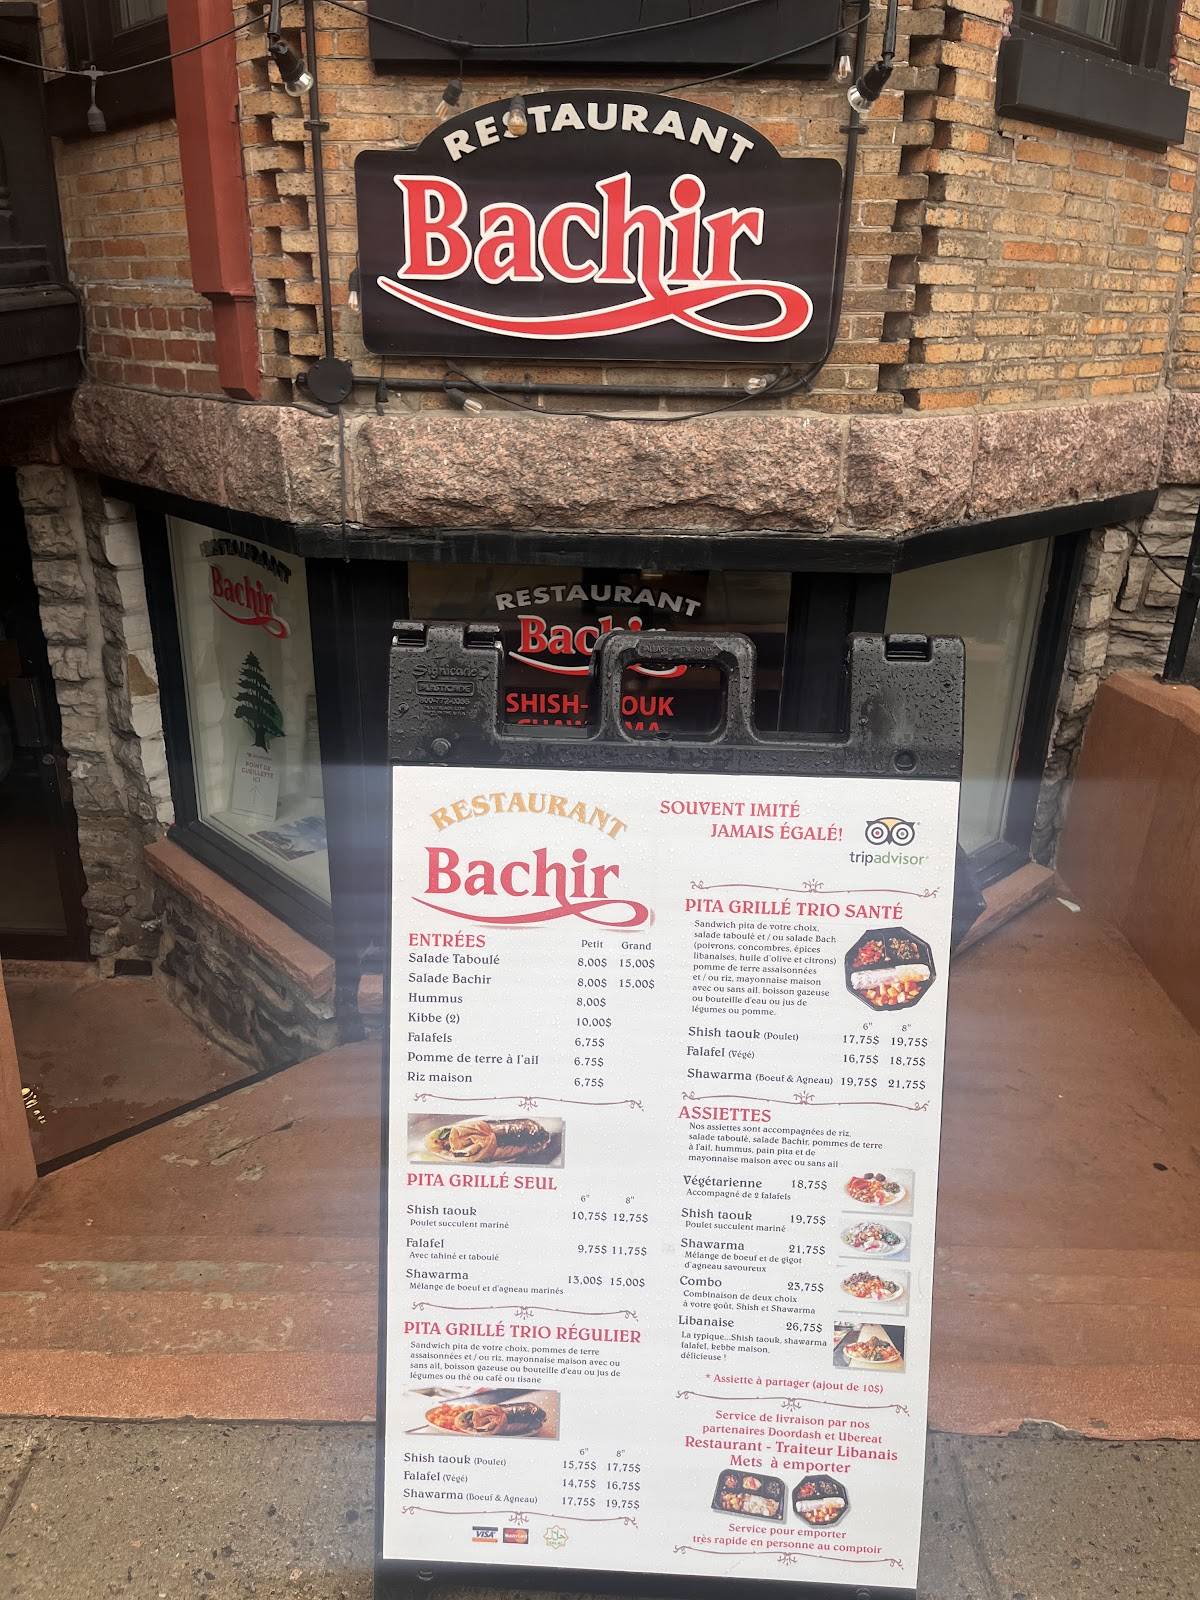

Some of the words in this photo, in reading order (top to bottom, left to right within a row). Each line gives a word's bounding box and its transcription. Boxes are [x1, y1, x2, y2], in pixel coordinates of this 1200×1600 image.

[442, 102, 754, 164] RESTAURANT
[377, 172, 814, 342] Bachir
[496, 584, 701, 616] RESTAURANT
[660, 801, 745, 816] SOUVENT
[750, 800, 800, 817] IMITÉ
[430, 792, 628, 840] RESTAURANT
[711, 824, 774, 839] JAMAIS
[780, 822, 842, 841] ÉGALÉ!
[849, 851, 924, 865] tripadvisor
[411, 847, 649, 927] Bachir
[685, 899, 723, 912] PITA
[729, 898, 790, 915] GRILLÉ
[797, 903, 840, 917] TRIO
[845, 902, 902, 919] SANTÉ
[694, 920, 735, 928] Sandwich
[739, 922, 754, 930] pita
[409, 930, 485, 948] ENTRÉES
[582, 940, 602, 948] Petit
[622, 942, 651, 950] Grand
[409, 953, 449, 963] Salade
[453, 954, 499, 964] Taboulé
[409, 973, 448, 983] Salade
[453, 974, 491, 984] Bachir
[409, 993, 462, 1003] Hummus
[409, 1013, 442, 1022] Kibbe
[446, 1013, 459, 1024] (2)
[408, 1032, 452, 1042] Falafels
[689, 1027, 721, 1037] Shish
[726, 1029, 760, 1038] taouk
[764, 1032, 798, 1041] (Poulet)
[408, 1052, 453, 1062] Pomme
[457, 1053, 471, 1062] de
[475, 1055, 502, 1063] terre
[506, 1054, 512, 1063] à
[517, 1055, 538, 1064] l'ail
[687, 1046, 725, 1057] Falafel
[729, 1050, 754, 1059] (Végé)
[408, 1072, 425, 1081] Riz
[429, 1073, 472, 1082] maison
[687, 1068, 751, 1080] Shawarma
[756, 1074, 785, 1082] (Boeuf
[796, 1076, 833, 1085] Agneau)
[678, 1106, 771, 1122] ASSIETTES
[407, 1173, 444, 1186] PITA
[449, 1172, 508, 1188] GRILLÉ
[514, 1176, 557, 1190] SEUL
[683, 1175, 762, 1188] Végétarienne
[407, 1205, 439, 1214] Shish
[443, 1207, 476, 1215] taouk
[681, 1208, 713, 1218] Shish
[718, 1211, 752, 1220] taouk
[407, 1238, 444, 1248] Falafel
[681, 1238, 744, 1250] Shawarma
[406, 1269, 468, 1279] Shawarma
[680, 1276, 721, 1287] Combo
[679, 1315, 734, 1327] Libanaise
[404, 1322, 441, 1334] PITA
[446, 1321, 504, 1337] GRILLÉ
[510, 1325, 551, 1338] TRIO
[556, 1324, 640, 1343] RÉGULIER
[714, 1374, 753, 1384] Assiette
[756, 1376, 761, 1384] à
[766, 1379, 810, 1389] partager
[813, 1381, 843, 1390] (ajout
[847, 1383, 859, 1391] de
[864, 1385, 883, 1393] 10$)
[716, 1410, 756, 1421] Service
[760, 1413, 772, 1422] de
[776, 1414, 824, 1425] livraison
[828, 1420, 847, 1428] par
[850, 1421, 869, 1429] nos
[703, 1426, 764, 1435] partenaires
[769, 1427, 821, 1439] Doordash
[839, 1432, 881, 1443] Ubereat
[685, 1436, 761, 1451] Restaurant
[776, 1441, 833, 1455] Traiteur
[837, 1446, 897, 1460] Libanais
[404, 1453, 434, 1462] Shish
[439, 1455, 470, 1464] taouk
[474, 1458, 506, 1466] (Poulet)
[730, 1455, 762, 1467] Mets
[771, 1457, 777, 1468] à
[783, 1461, 850, 1472] emporter
[404, 1471, 440, 1481] Falafel
[443, 1474, 467, 1483] (Végé)
[403, 1488, 463, 1499] Shawarma
[466, 1493, 493, 1501] (Boeuf
[504, 1495, 537, 1504] Agneau)
[729, 1524, 766, 1533] Service
[798, 1530, 846, 1538] emporter
[693, 1536, 711, 1544] très
[715, 1537, 747, 1546] rapide
[767, 1541, 814, 1549] personne
[834, 1545, 881, 1554] comptoir
